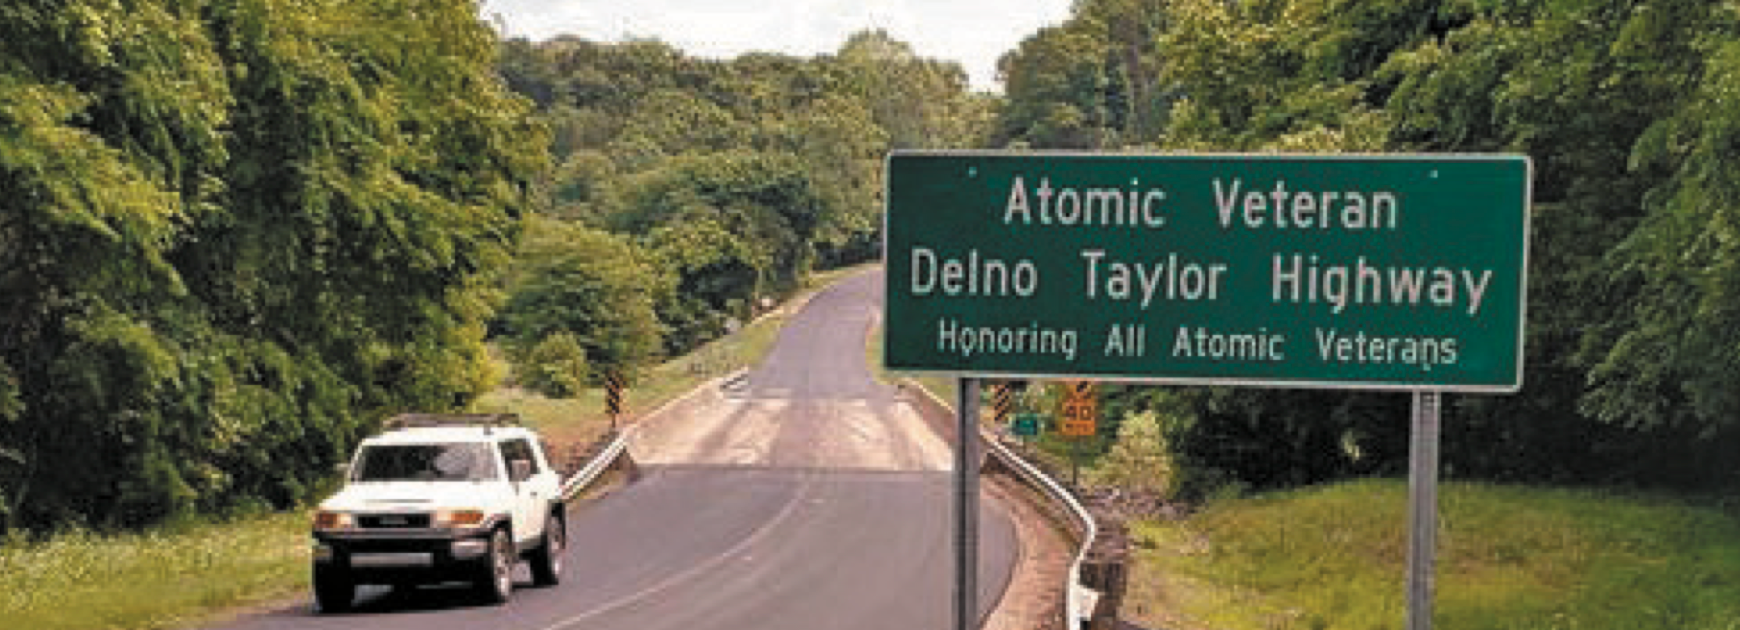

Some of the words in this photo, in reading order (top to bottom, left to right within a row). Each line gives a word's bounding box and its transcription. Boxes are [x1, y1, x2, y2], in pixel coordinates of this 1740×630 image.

[1004, 177, 1165, 226] Atomic
[1213, 178, 1397, 229] Veteran
[910, 248, 1038, 297] Delno
[1082, 250, 1227, 308] Taylor
[1272, 254, 1493, 315] Highway
[938, 318, 1077, 360] Honoring
[1104, 324, 1145, 356] All
[1172, 326, 1284, 361] Atomic
[1315, 327, 1458, 365] Veterans
